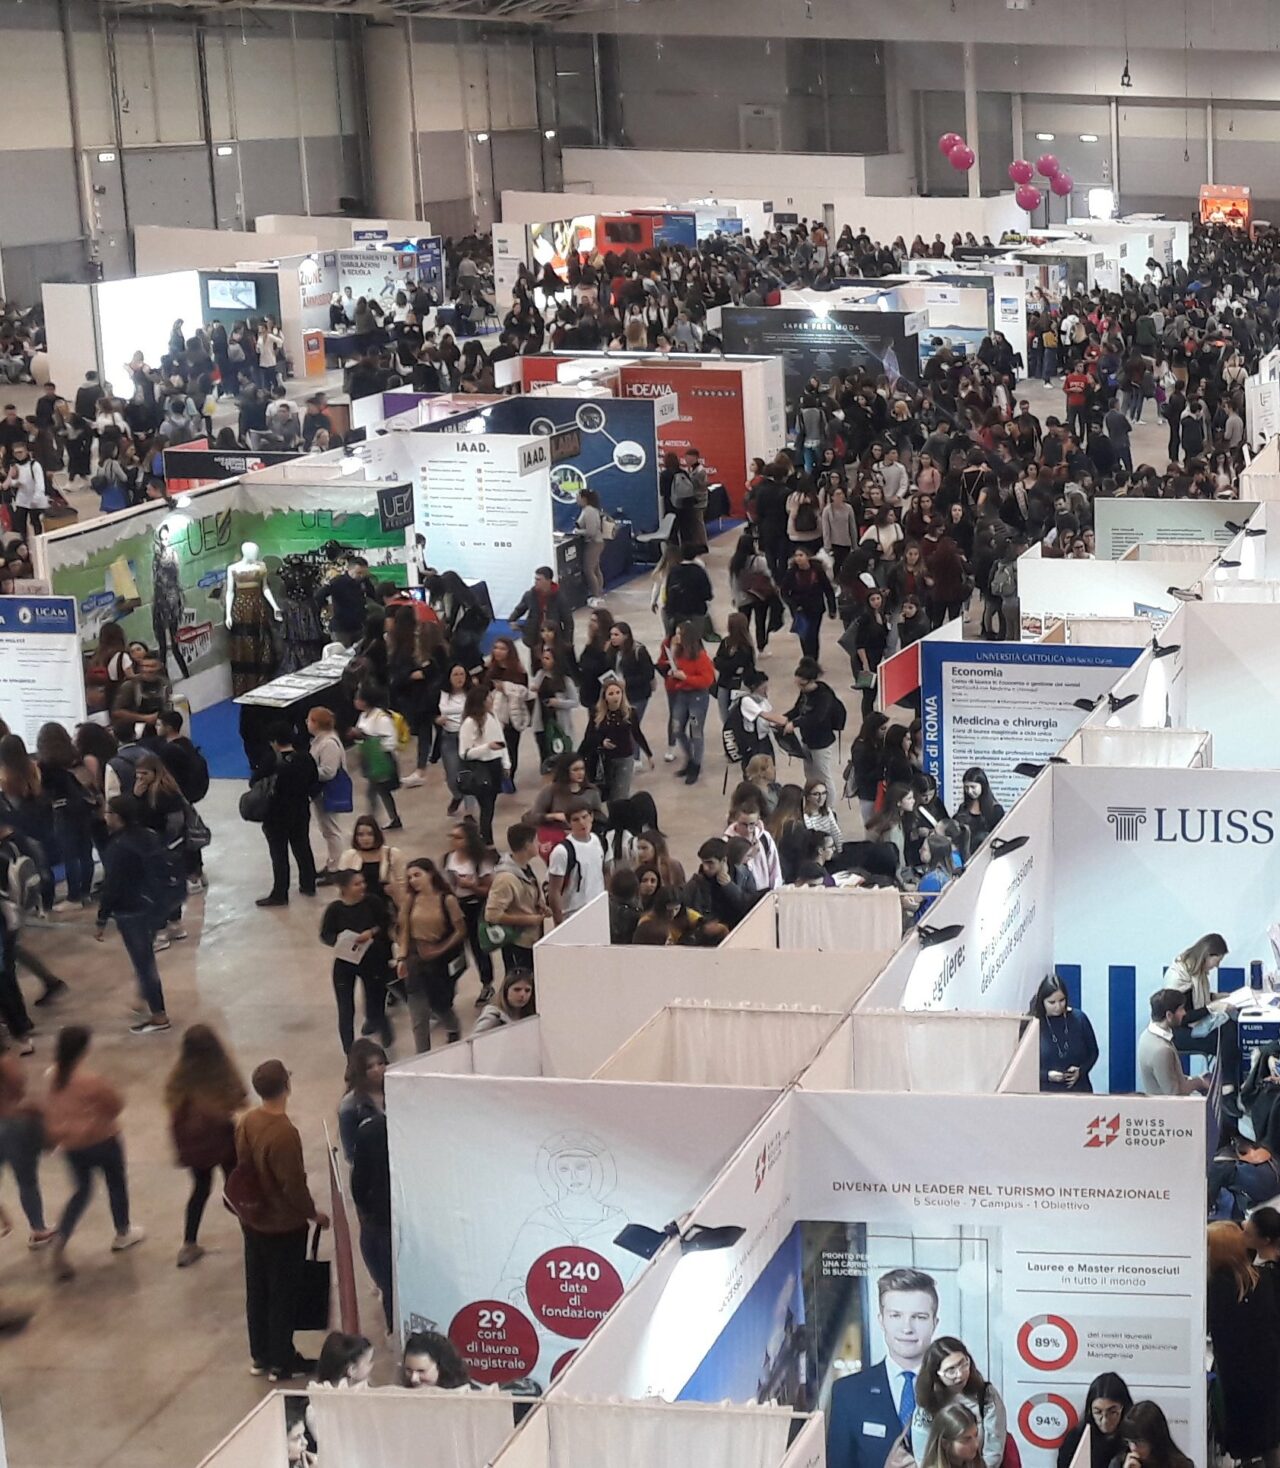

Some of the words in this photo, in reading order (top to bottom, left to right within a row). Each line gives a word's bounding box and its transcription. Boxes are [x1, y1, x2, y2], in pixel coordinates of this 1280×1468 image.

[456, 442, 490, 453] IAAD.
[523, 446, 547, 468] IAAD.
[35, 607, 68, 616] UCAM
[976, 652, 1020, 662] UNIVERSITÀ
[1022, 653, 1065, 664] CATTOLICA
[951, 666, 1003, 678] Economia
[925, 695, 938, 741] ROMA
[952, 715, 1000, 727] Medicina
[1002, 719, 1010, 727] e
[1012, 717, 1058, 729] chirurgia
[926, 744, 938, 757] di
[1154, 807, 1274, 844] LUISS
[1125, 1117, 1165, 1127] SWISS
[1125, 1128, 1193, 1138] EDUCATION
[1125, 1137, 1166, 1147] GROUP
[832, 1181, 888, 1193] DIVENTA
[891, 1183, 911, 1193] UN
[914, 1184, 965, 1195] LEADER
[968, 1185, 992, 1196] NEL
[997, 1186, 1056, 1197] TURISMO
[1059, 1188, 1171, 1200] INTERNAZIONALE
[924, 1198, 960, 1208] Scuole
[980, 1199, 1023, 1210] Campus
[1041, 1200, 1090, 1211] Obiettivo
[822, 1252, 854, 1260] PRONTO
[545, 1260, 600, 1281] 1240
[1027, 1261, 1064, 1273] Lauree
[1067, 1265, 1074, 1273] e
[1077, 1263, 1114, 1274] Master
[1117, 1264, 1180, 1275] riconosciuti
[1061, 1275, 1071, 1284] in
[1074, 1276, 1098, 1286] tutto
[1110, 1276, 1147, 1287] mondo
[560, 1282, 588, 1294] data
[569, 1295, 581, 1306] di
[541, 1305, 609, 1319] fondazione
[478, 1309, 506, 1328] 29
[477, 1329, 506, 1340] corsi
[467, 1342, 478, 1353] di
[481, 1342, 519, 1355] laurea
[1035, 1337, 1060, 1348] 89%
[464, 1357, 526, 1370] magistrale
[1035, 1415, 1061, 1427] 94%
